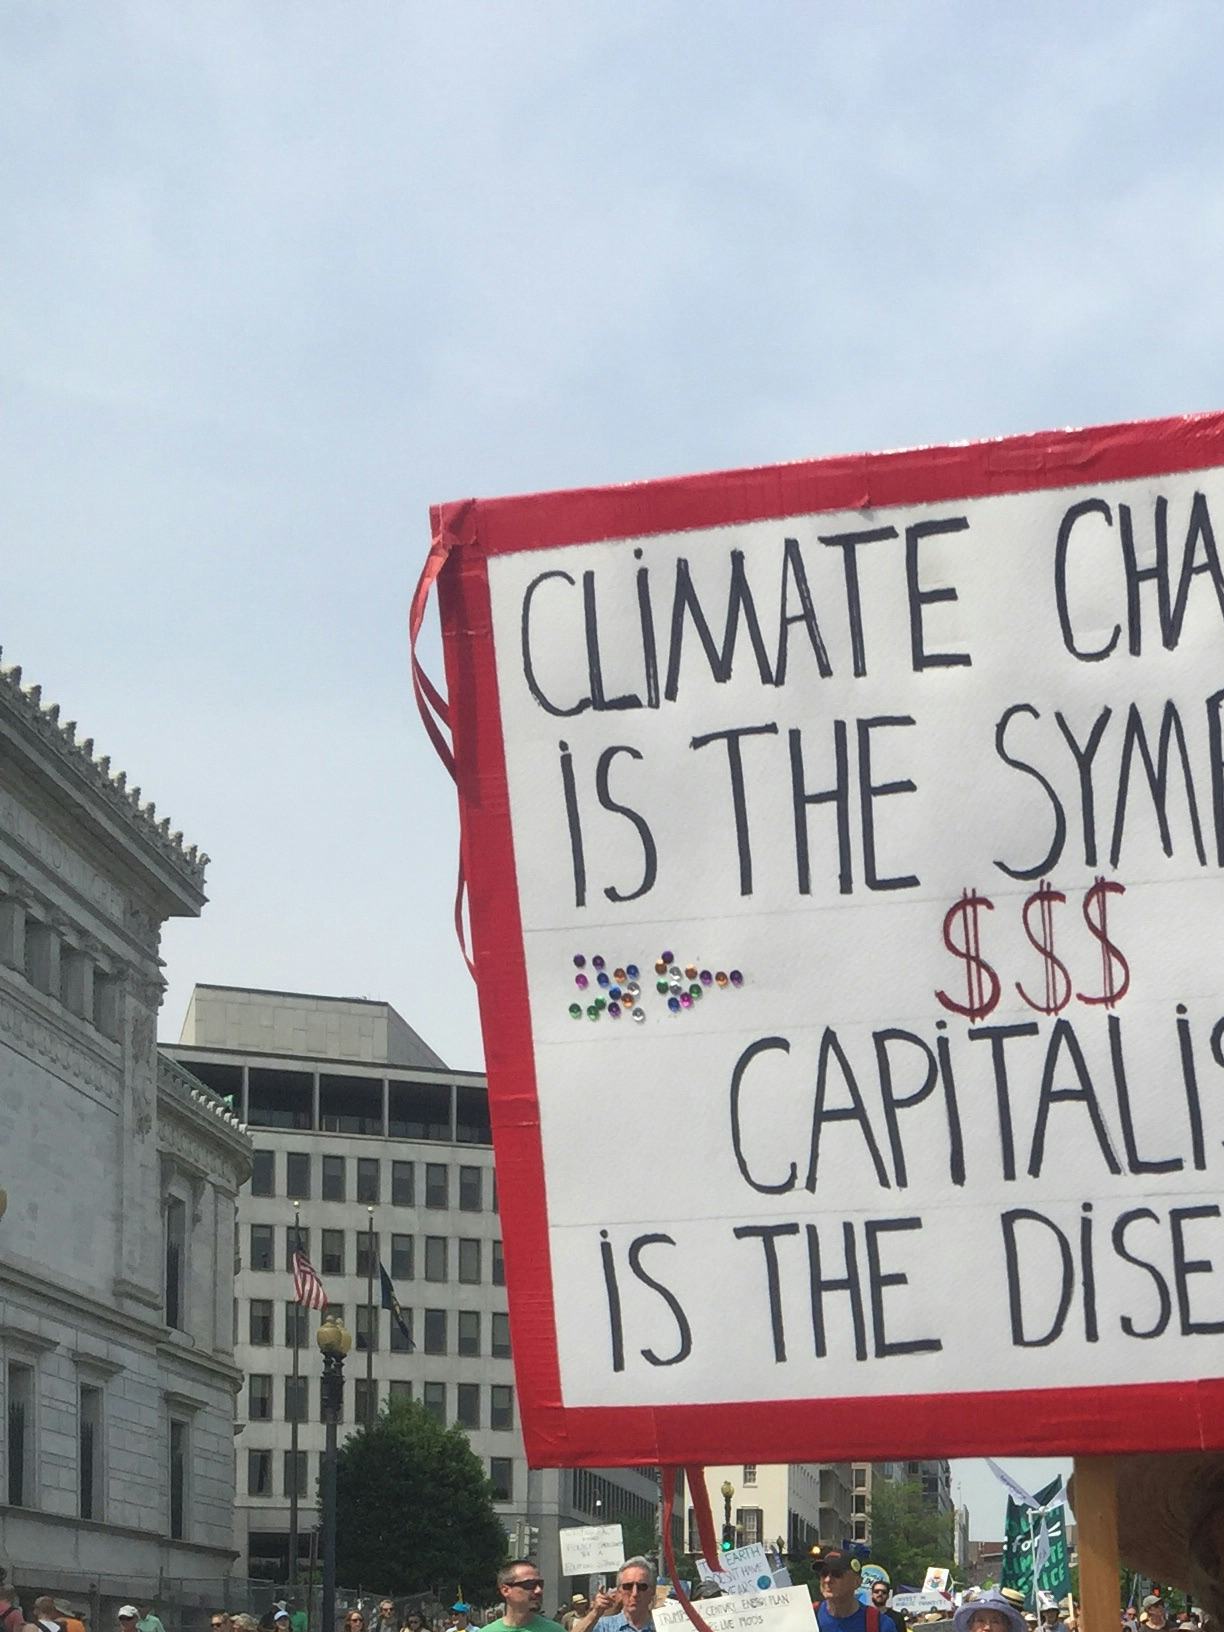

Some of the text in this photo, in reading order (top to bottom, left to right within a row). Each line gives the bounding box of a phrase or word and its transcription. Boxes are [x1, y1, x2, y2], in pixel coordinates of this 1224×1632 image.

[522, 516, 972, 717] CLIMATE
[690, 716, 921, 897] THE
[733, 1217, 943, 1364] THE
[724, 1546, 760, 1566] EARTH
